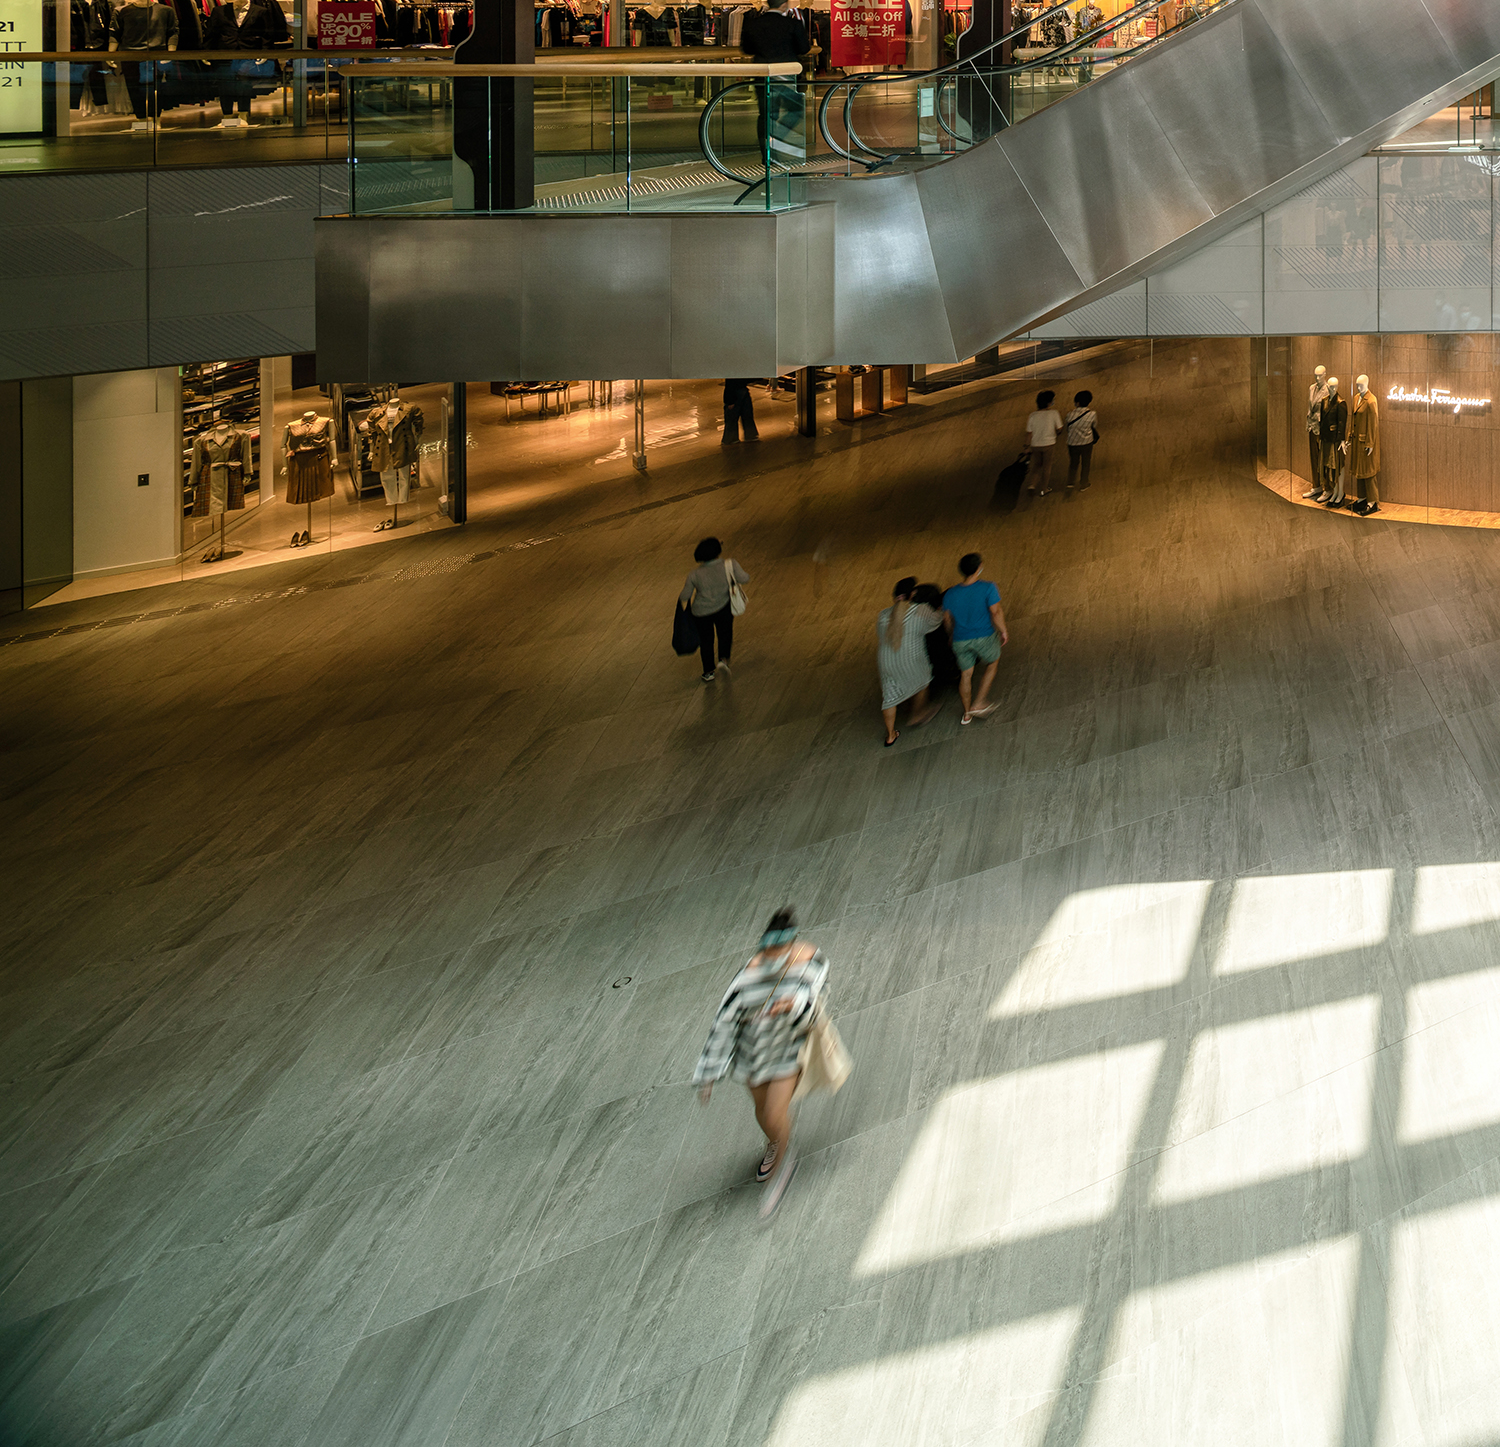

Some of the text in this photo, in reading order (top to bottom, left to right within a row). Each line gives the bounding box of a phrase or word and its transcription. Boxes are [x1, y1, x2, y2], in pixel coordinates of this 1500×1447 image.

[320, 13, 373, 23] SALE
[834, 11, 903, 22] All 80% Off
[321, 36, 373, 45] 低至一折
